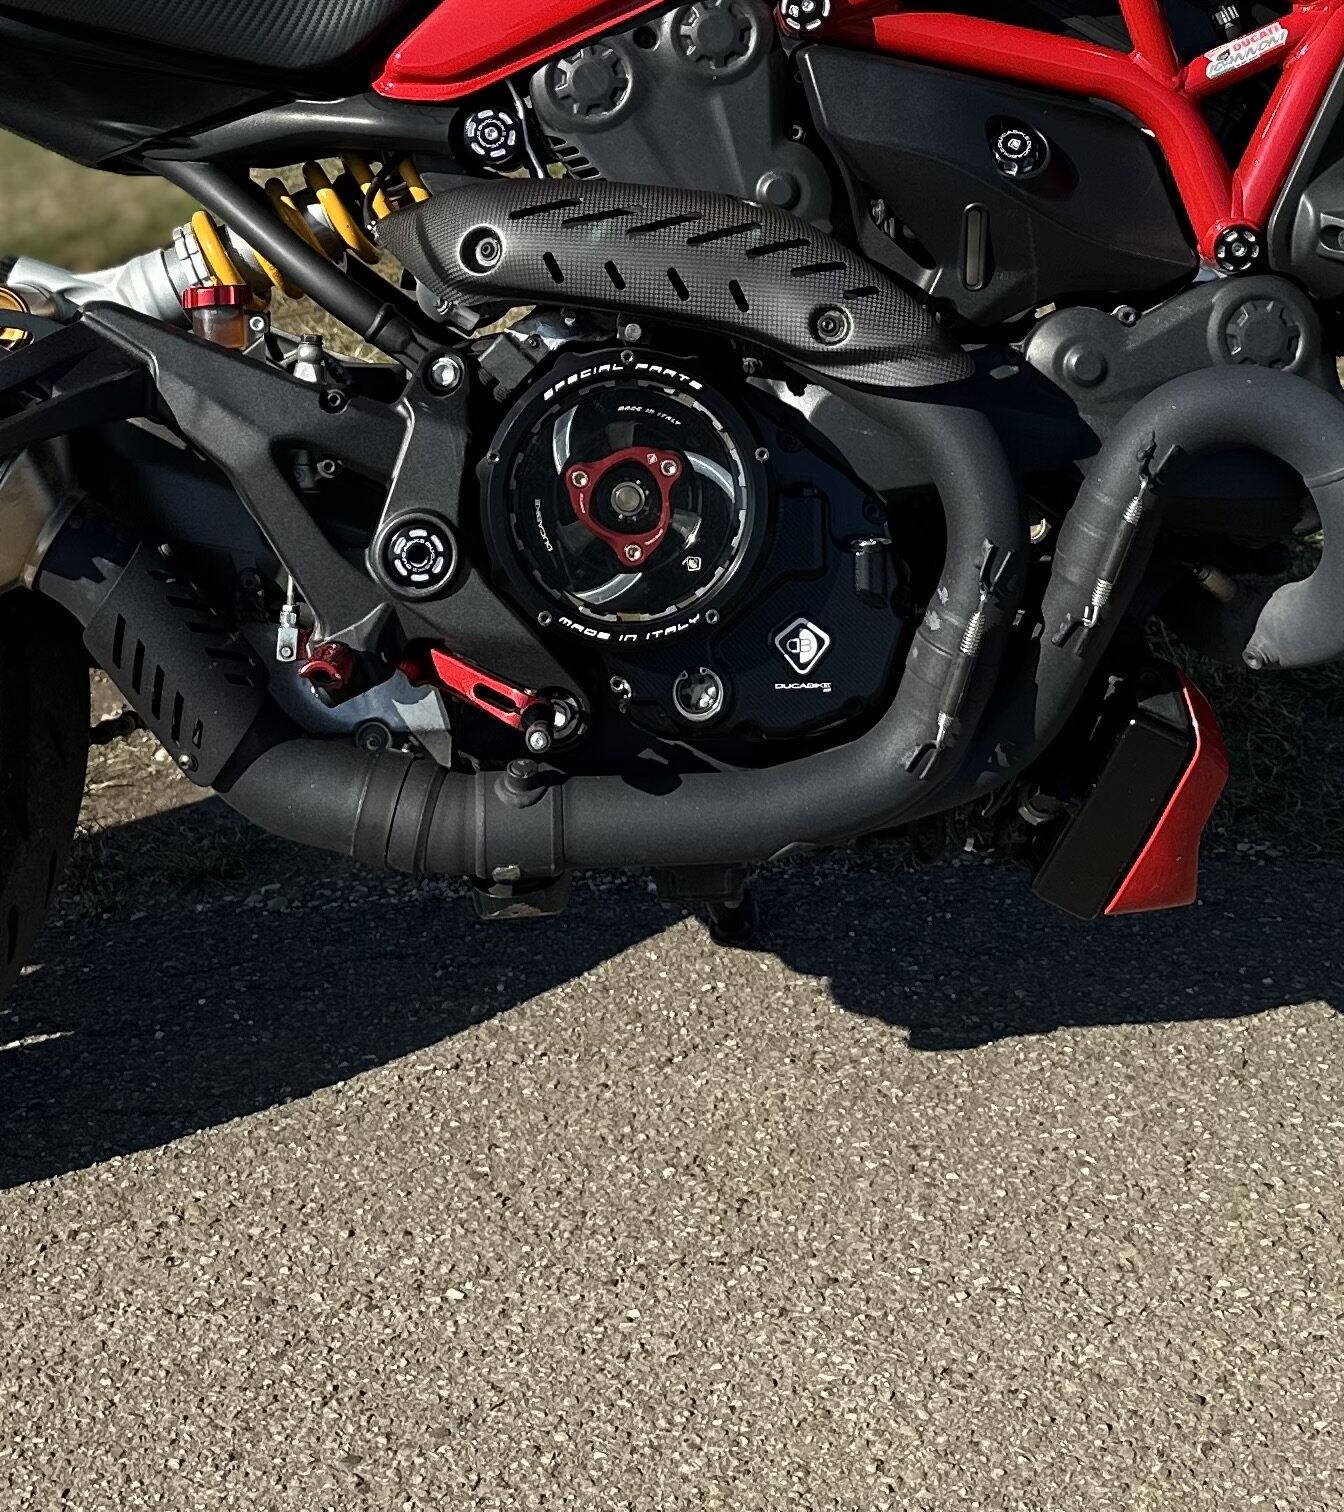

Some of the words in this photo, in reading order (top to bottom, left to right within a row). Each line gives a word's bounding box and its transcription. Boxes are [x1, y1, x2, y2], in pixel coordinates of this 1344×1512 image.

[1232, 25, 1280, 51] DUCATI
[544, 363, 623, 400] SPECIAL
[635, 363, 703, 390] PARTS
[657, 411, 682, 426] ITALY
[559, 616, 611, 640] MADE
[619, 634, 637, 642] IN
[646, 614, 700, 640] ITALY
